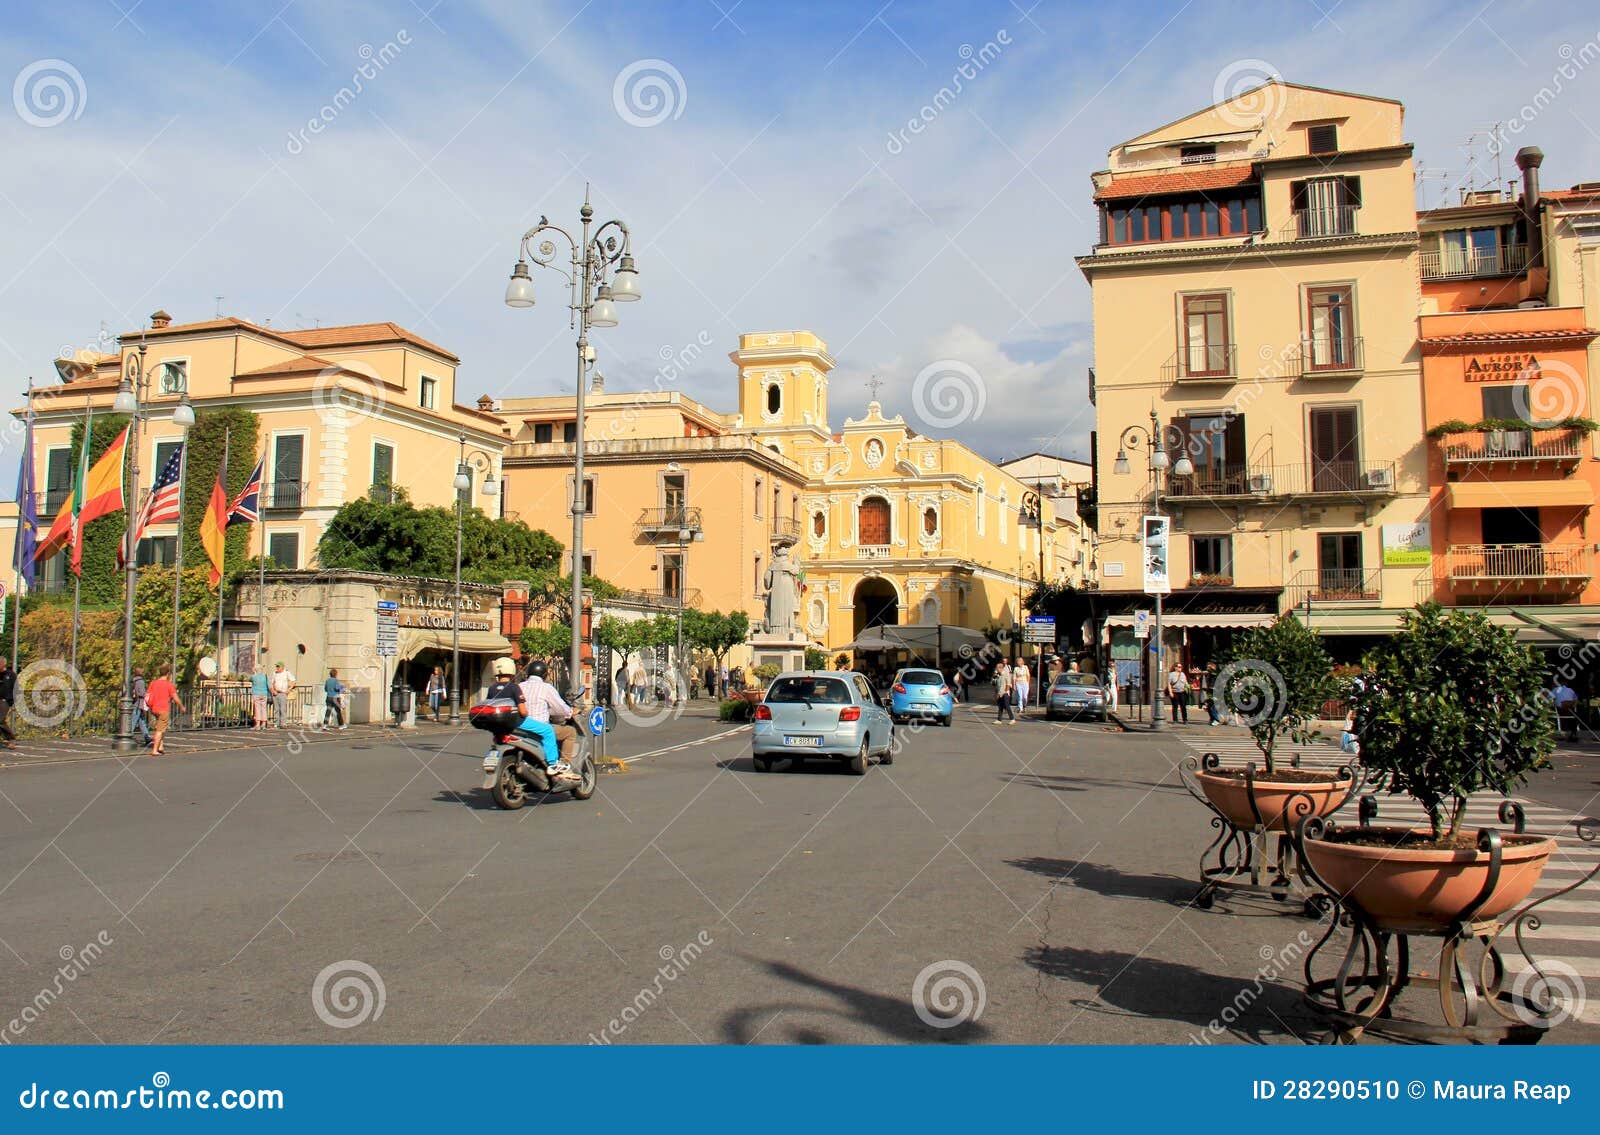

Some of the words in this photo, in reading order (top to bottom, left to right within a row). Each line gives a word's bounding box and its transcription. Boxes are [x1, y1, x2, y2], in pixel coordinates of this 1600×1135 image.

[1467, 354, 1541, 373] AURORA
[401, 593, 453, 609] ITALICA
[459, 598, 481, 611] ARS
[419, 615, 455, 628] CUOMO
